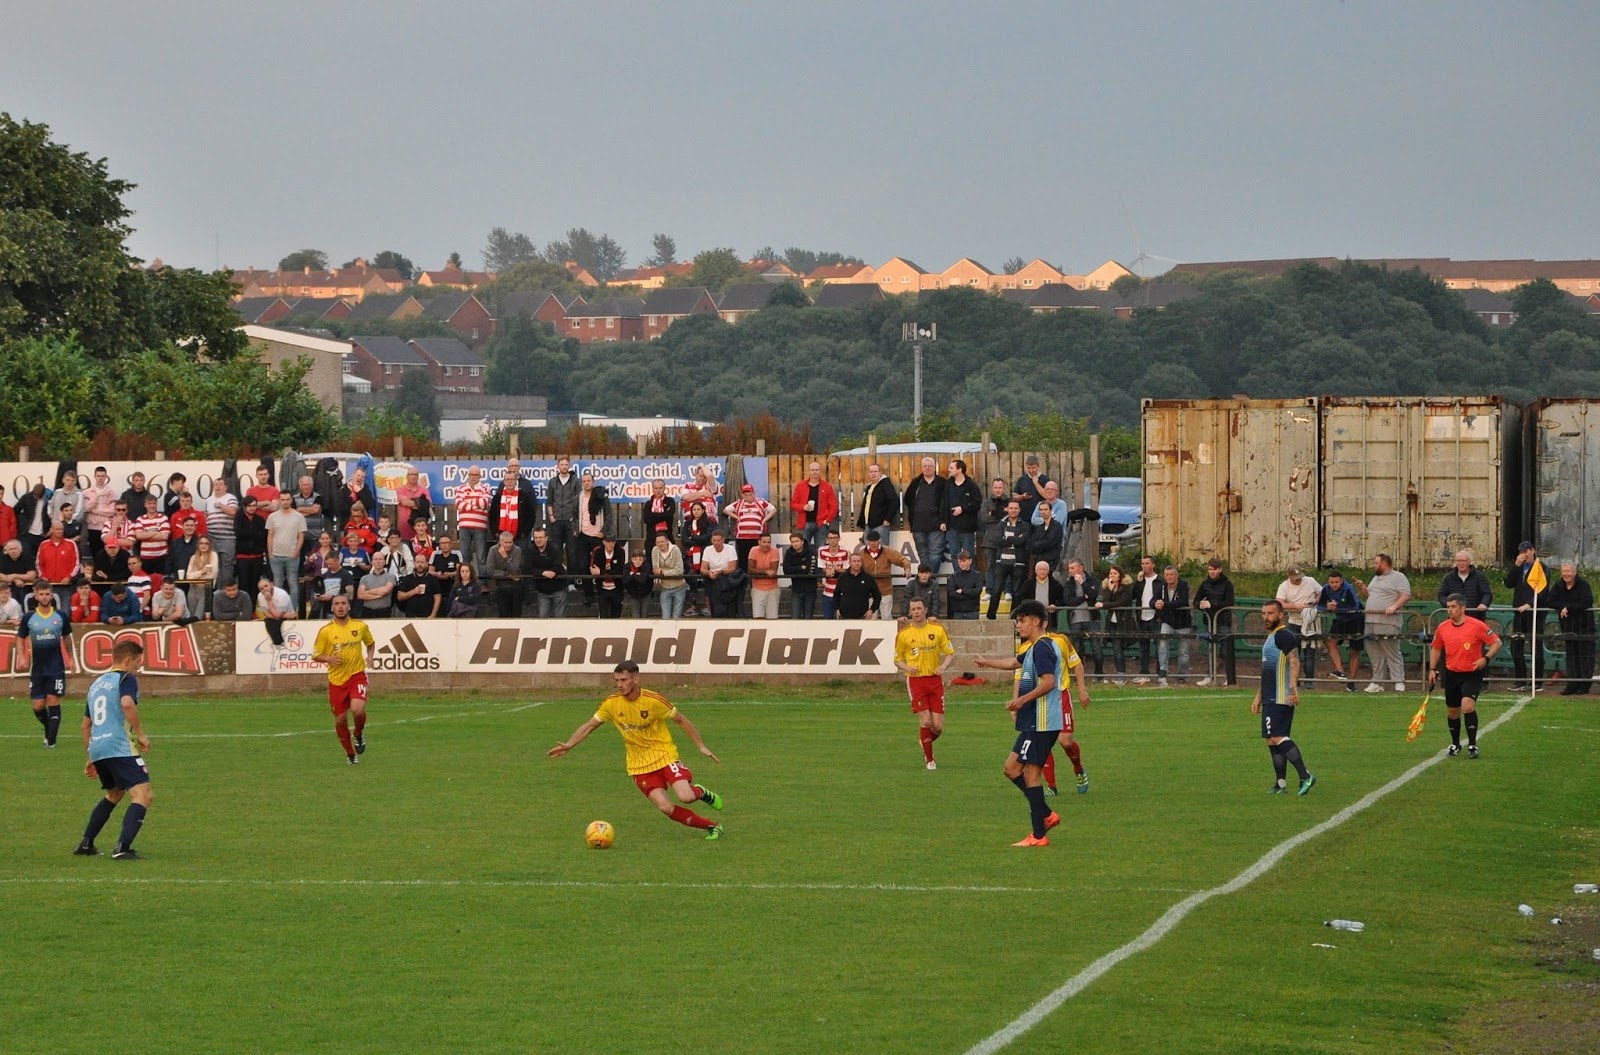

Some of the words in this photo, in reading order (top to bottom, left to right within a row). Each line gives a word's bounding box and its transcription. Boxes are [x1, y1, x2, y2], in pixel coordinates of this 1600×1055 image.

[444, 465, 456, 479] If
[459, 468, 487, 482] yu
[520, 465, 578, 480] worrd
[583, 464, 625, 479] about
[627, 469, 640, 479] a
[643, 463, 686, 480] child,
[689, 464, 721, 478] vit
[469, 628, 697, 665] Arnold
[709, 628, 885, 665] Clark
[373, 653, 440, 671] adidas
[55, 679, 64, 690] 16
[357, 684, 366, 695] 14
[94, 695, 107, 726] 8
[1265, 716, 1271, 730] 2
[669, 762, 680, 773] 8
